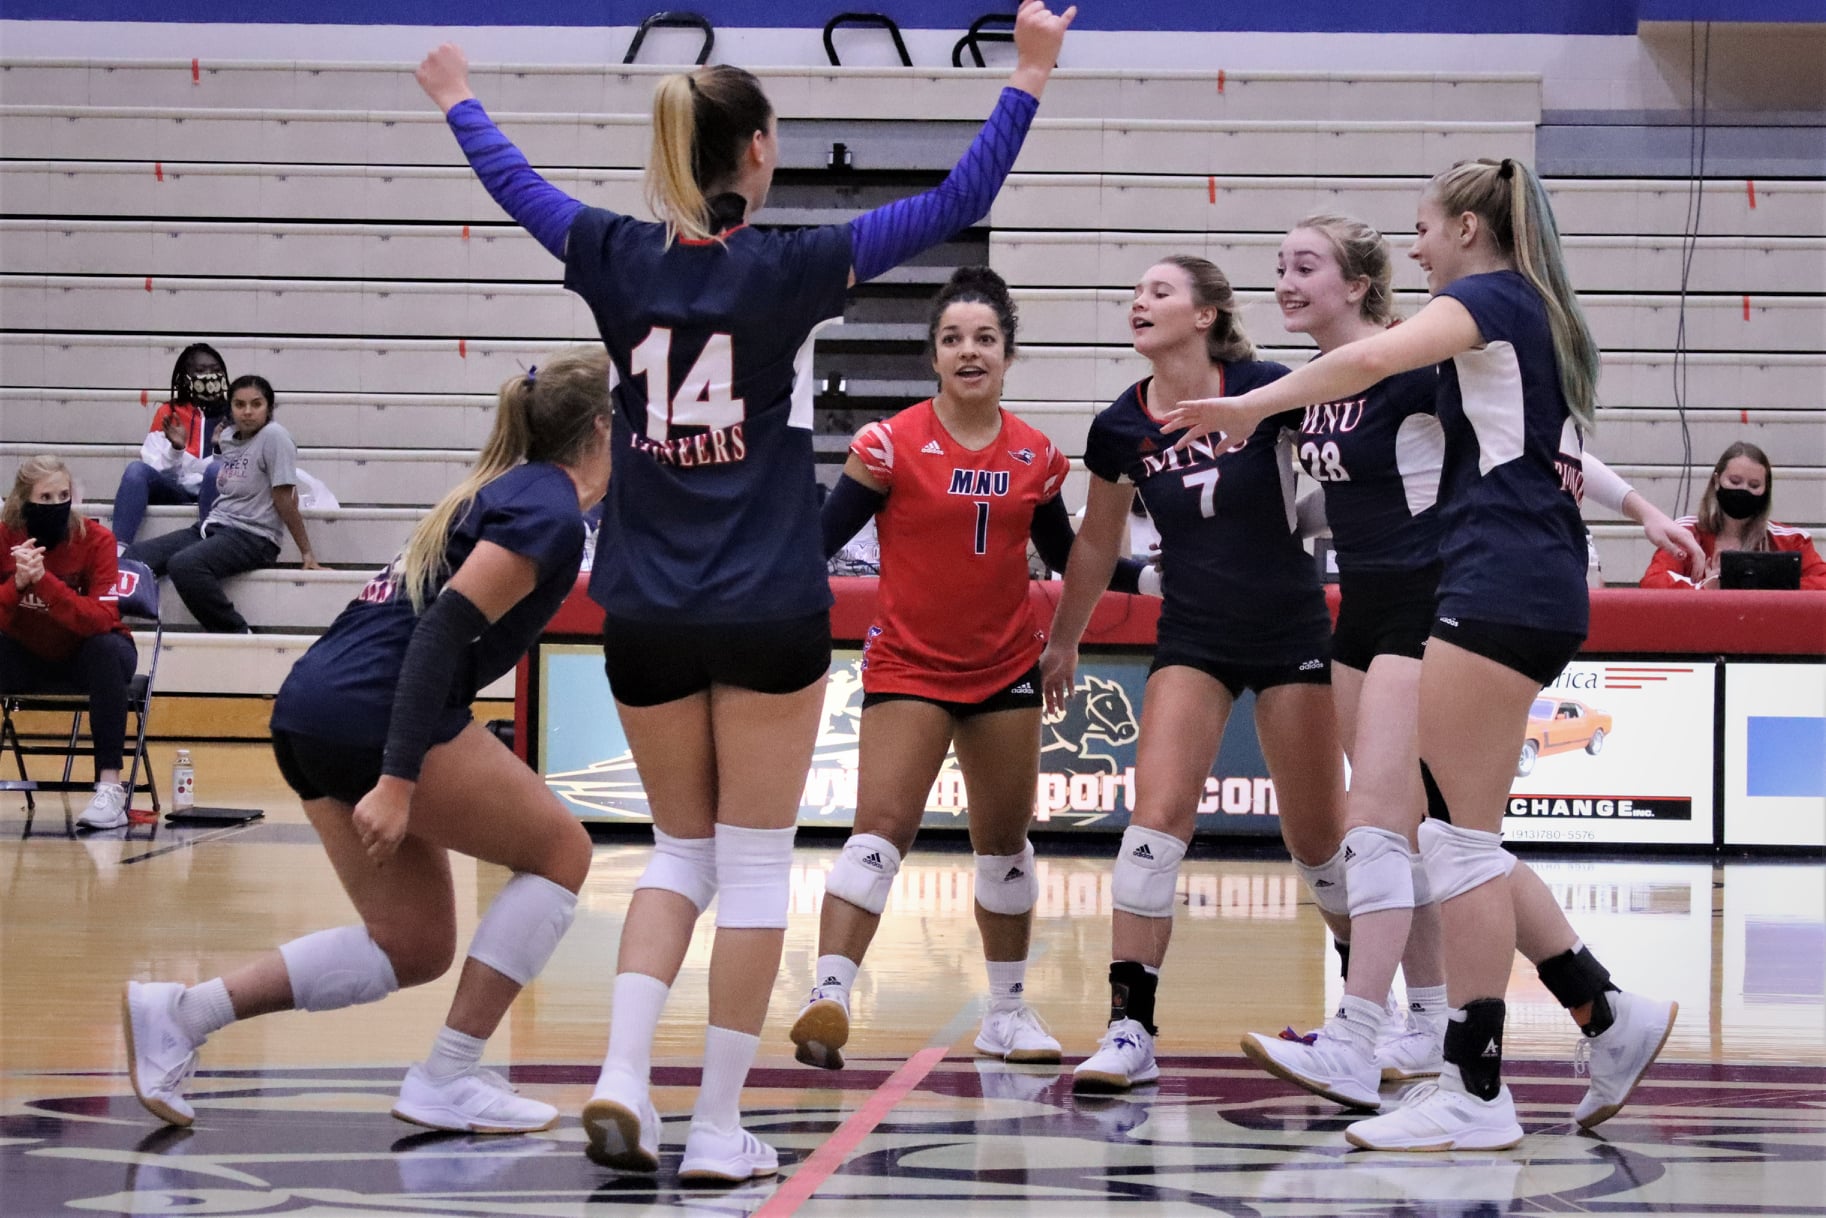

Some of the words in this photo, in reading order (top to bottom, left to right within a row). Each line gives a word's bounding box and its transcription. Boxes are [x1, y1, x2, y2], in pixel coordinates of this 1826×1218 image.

[630, 326, 745, 441] 14
[947, 467, 1010, 497] MNU
[1300, 441, 1351, 482] 28
[1182, 467, 1220, 518] 7
[973, 500, 990, 555] 1
